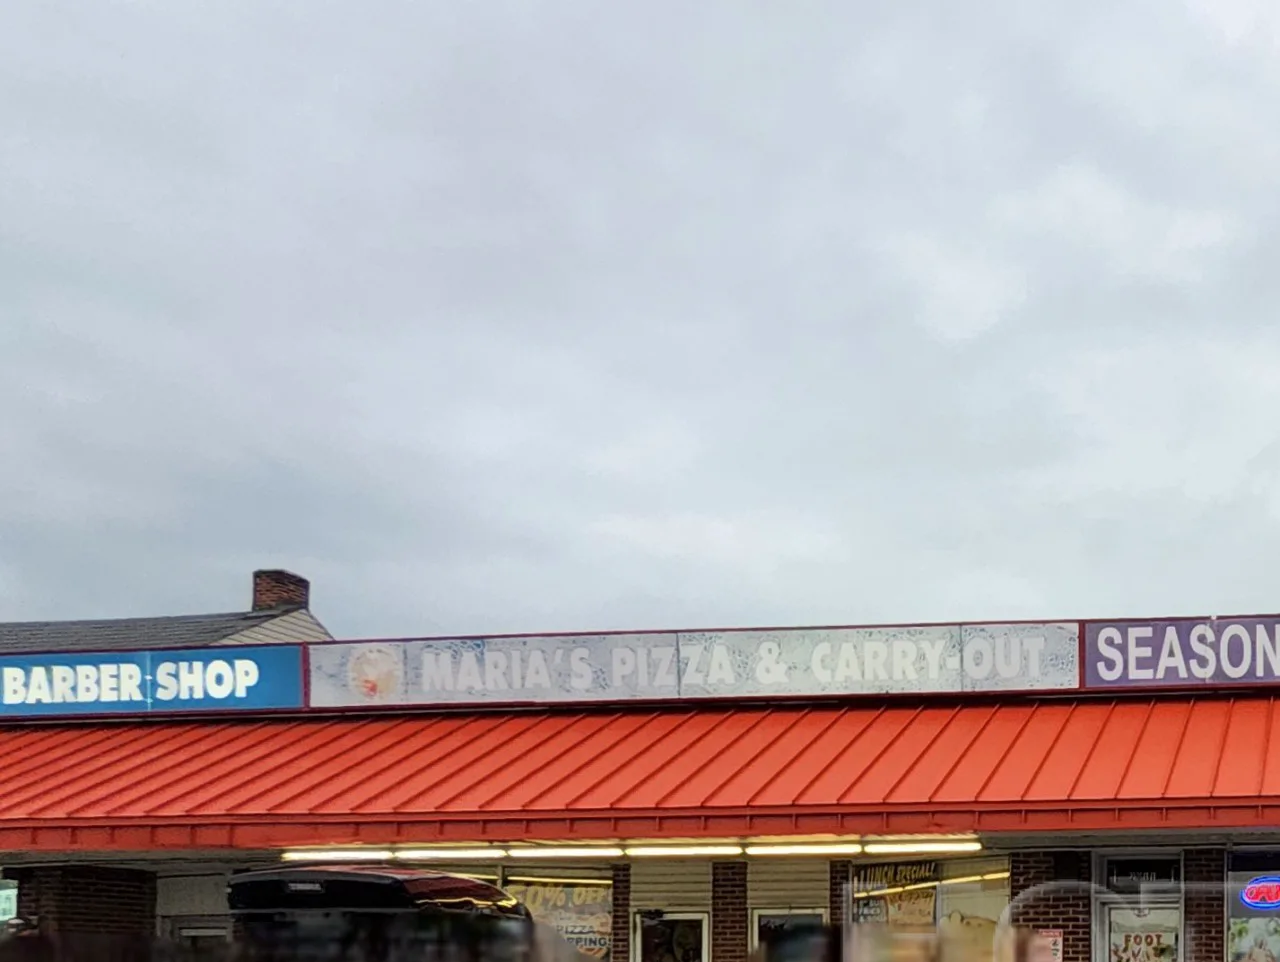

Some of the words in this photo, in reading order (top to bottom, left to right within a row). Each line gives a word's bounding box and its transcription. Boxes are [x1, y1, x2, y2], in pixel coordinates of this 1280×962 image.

[2, 663, 148, 705] BARBER
[155, 659, 260, 701] SHOP
[421, 647, 594, 692] MARIA'S
[610, 642, 736, 687] PIZZA
[754, 641, 789, 684] &
